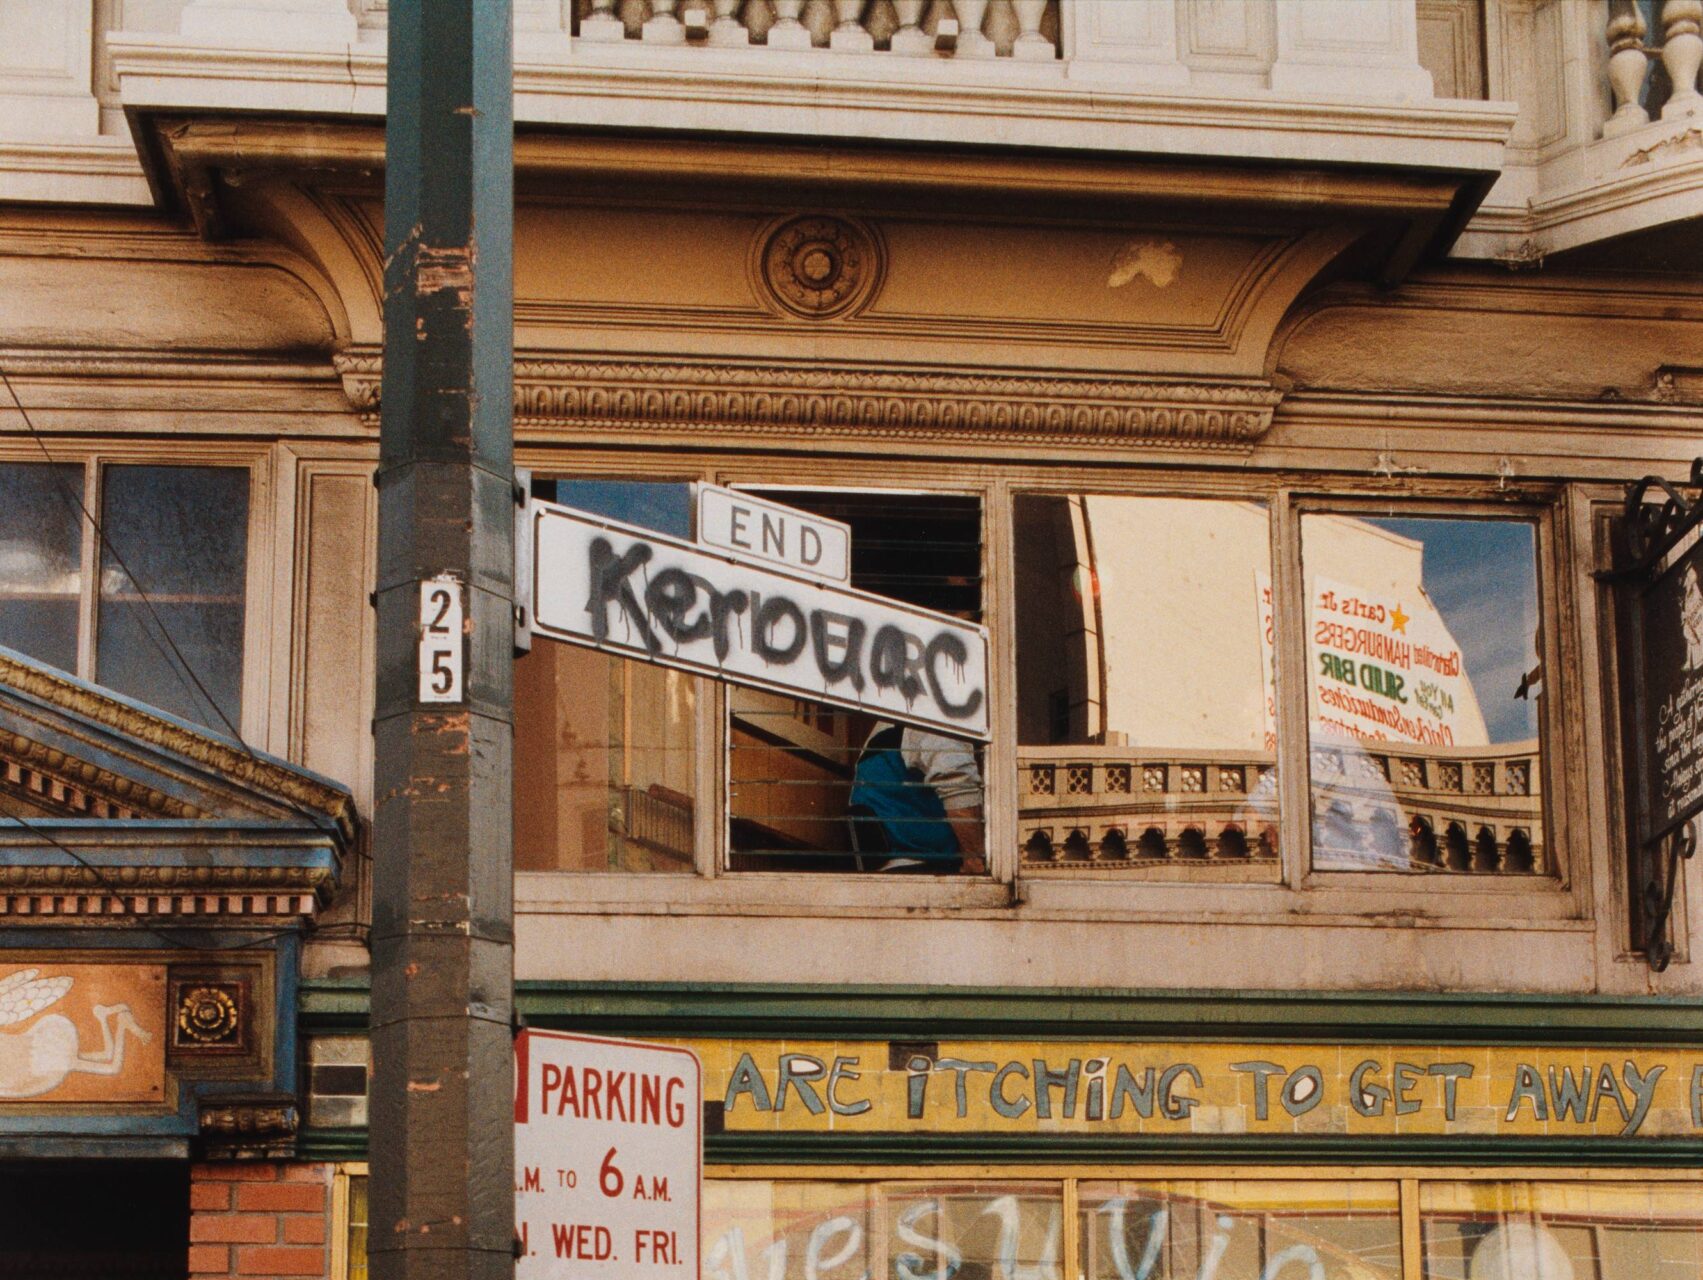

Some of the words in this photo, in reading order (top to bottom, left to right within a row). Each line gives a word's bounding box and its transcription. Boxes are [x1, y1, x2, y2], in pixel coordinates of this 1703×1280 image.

[730, 505, 823, 567] END
[542, 1063, 684, 1129] PARKING
[724, 1053, 872, 1116] ARE
[1229, 1060, 1324, 1121] TO
[1349, 1060, 1474, 1121] GET
[1505, 1060, 1668, 1137] AWAY
[557, 1169, 577, 1188] TO
[599, 1146, 624, 1198] 6
[633, 1175, 672, 1202] A.M.
[552, 1223, 618, 1262] WED.
[635, 1230, 683, 1265] FRI.
